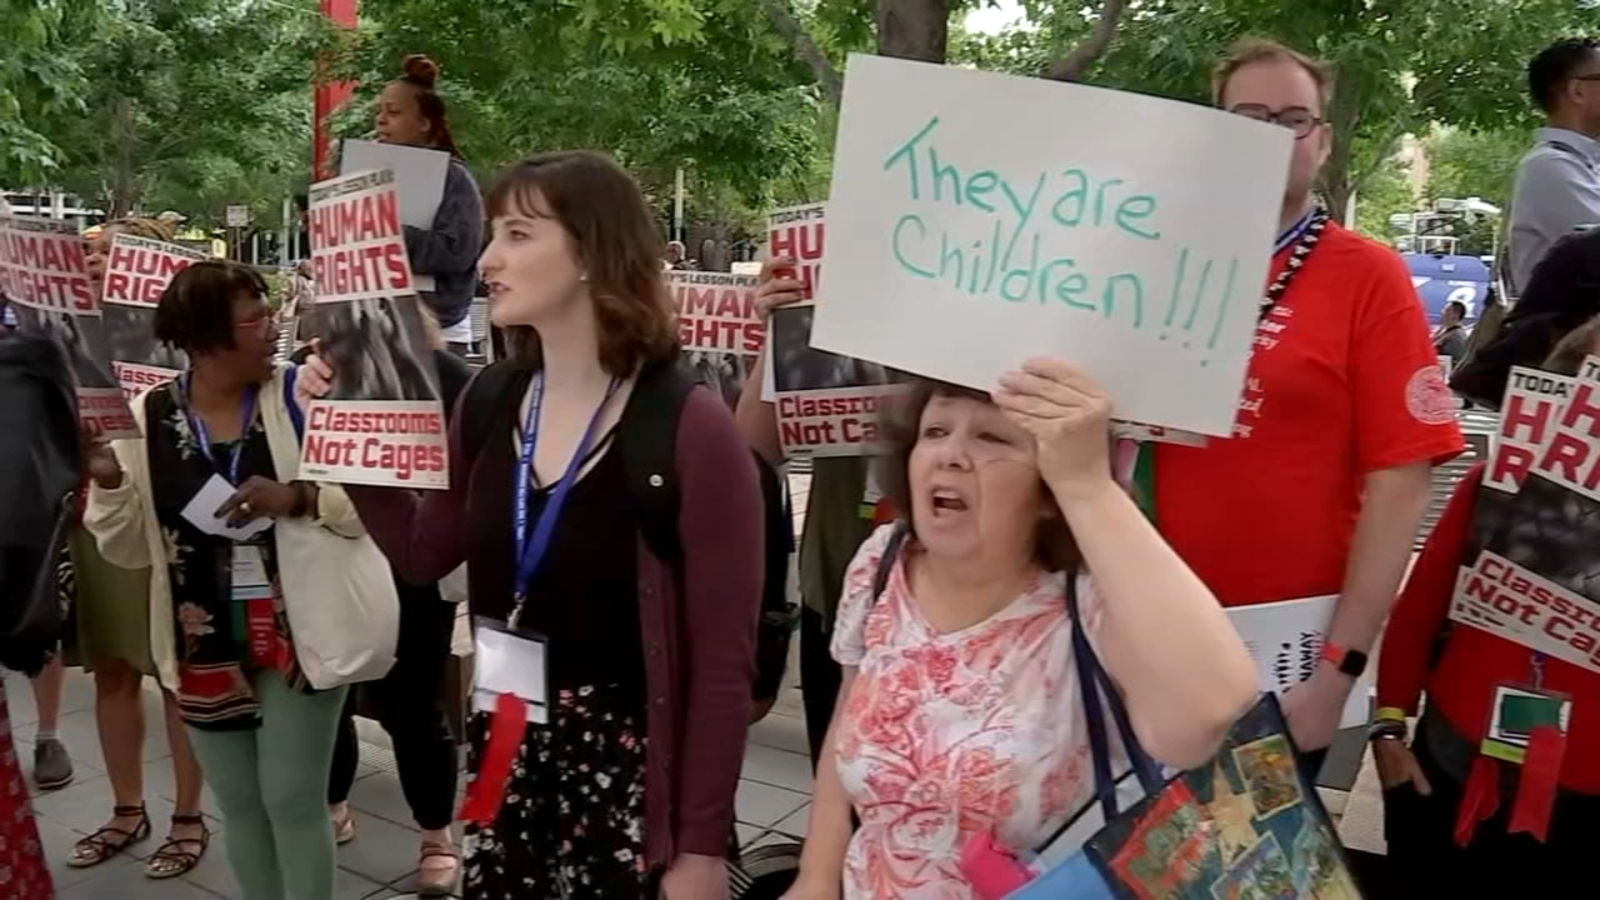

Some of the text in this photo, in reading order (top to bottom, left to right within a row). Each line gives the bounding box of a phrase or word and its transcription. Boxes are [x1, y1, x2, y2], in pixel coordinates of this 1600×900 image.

[770, 206, 825, 225] TODAY'S
[884, 116, 1160, 271] They are
[311, 190, 399, 251] HUMAN
[312, 243, 409, 295] RIGHTS
[690, 274, 733, 285] LESSON
[310, 406, 441, 434] Classrooms
[781, 421, 837, 446] Not
[304, 435, 444, 480] Not Cages
[1464, 576, 1541, 626] Not
